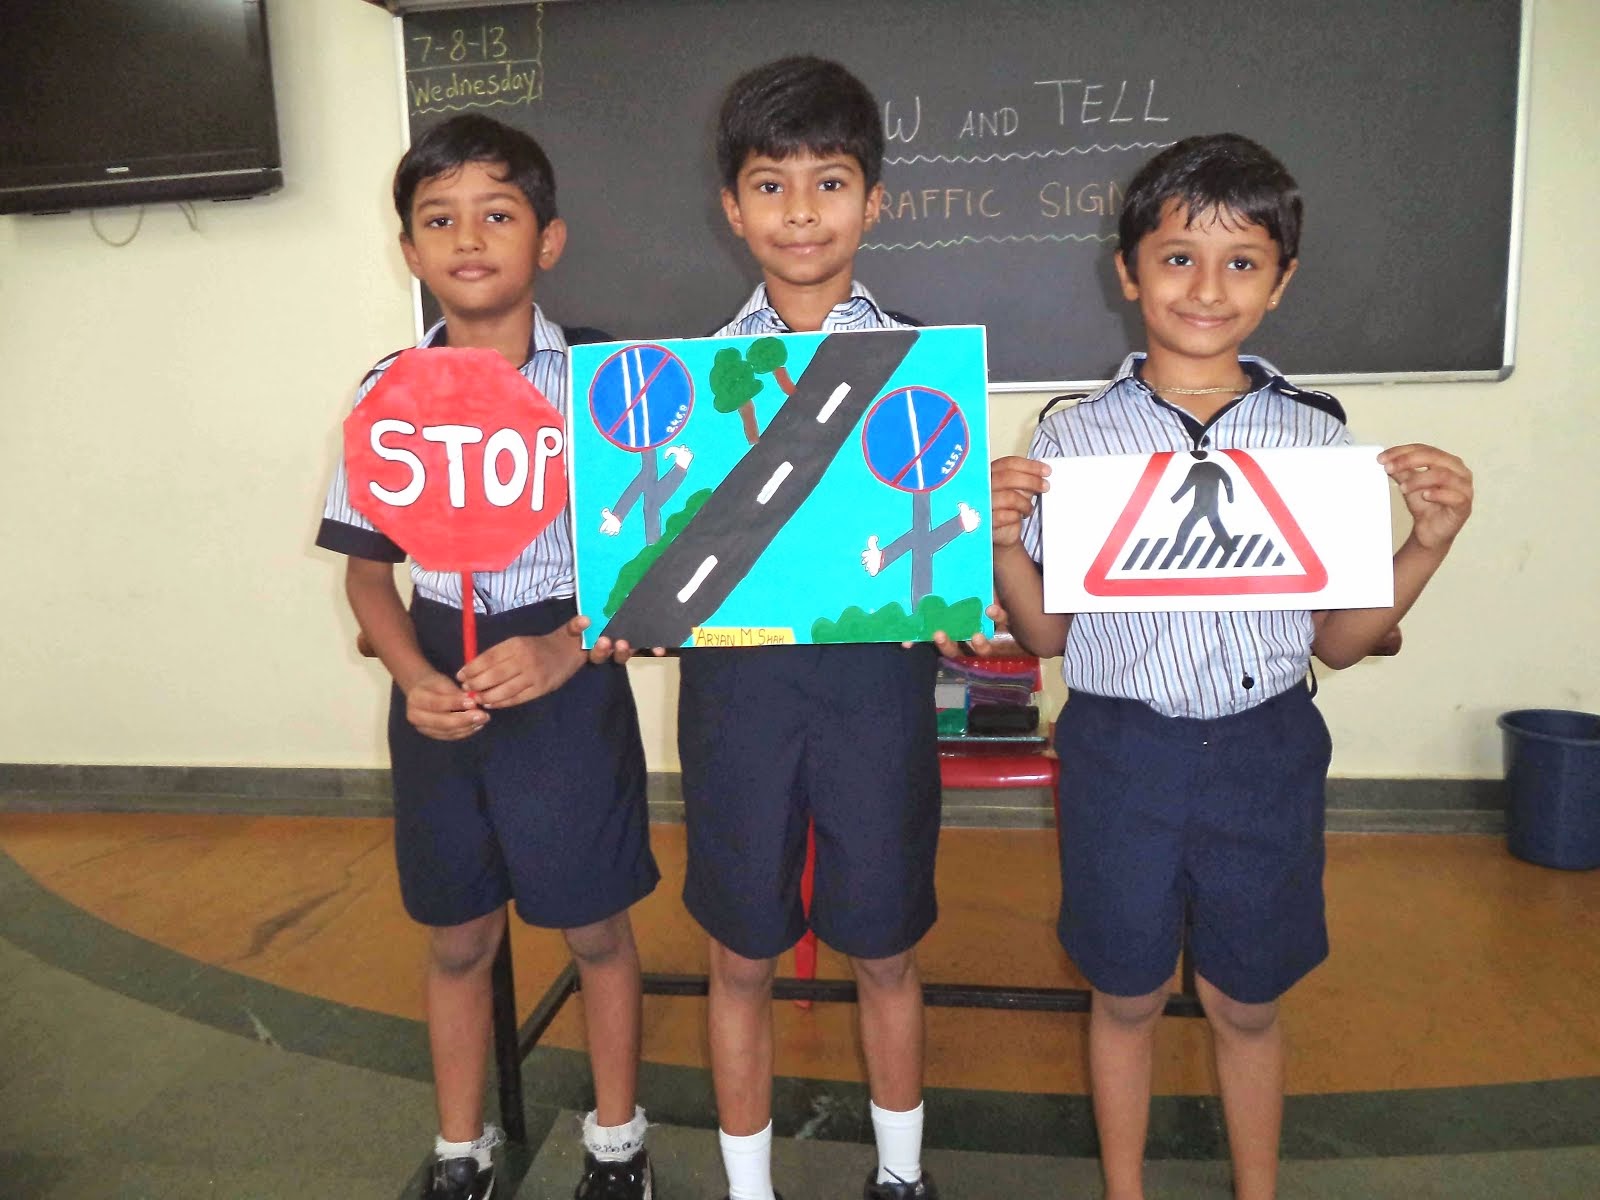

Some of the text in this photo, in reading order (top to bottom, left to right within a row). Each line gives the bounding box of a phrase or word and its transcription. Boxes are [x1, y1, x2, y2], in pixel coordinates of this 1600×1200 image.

[411, 26, 507, 62] 7-8-13
[408, 64, 536, 105] Wednesday
[883, 78, 1170, 142] W AND TELL
[878, 188, 1001, 222] RAFFIC
[368, 418, 564, 512] STOP
[695, 627, 785, 647] ARYAN M SHAH
